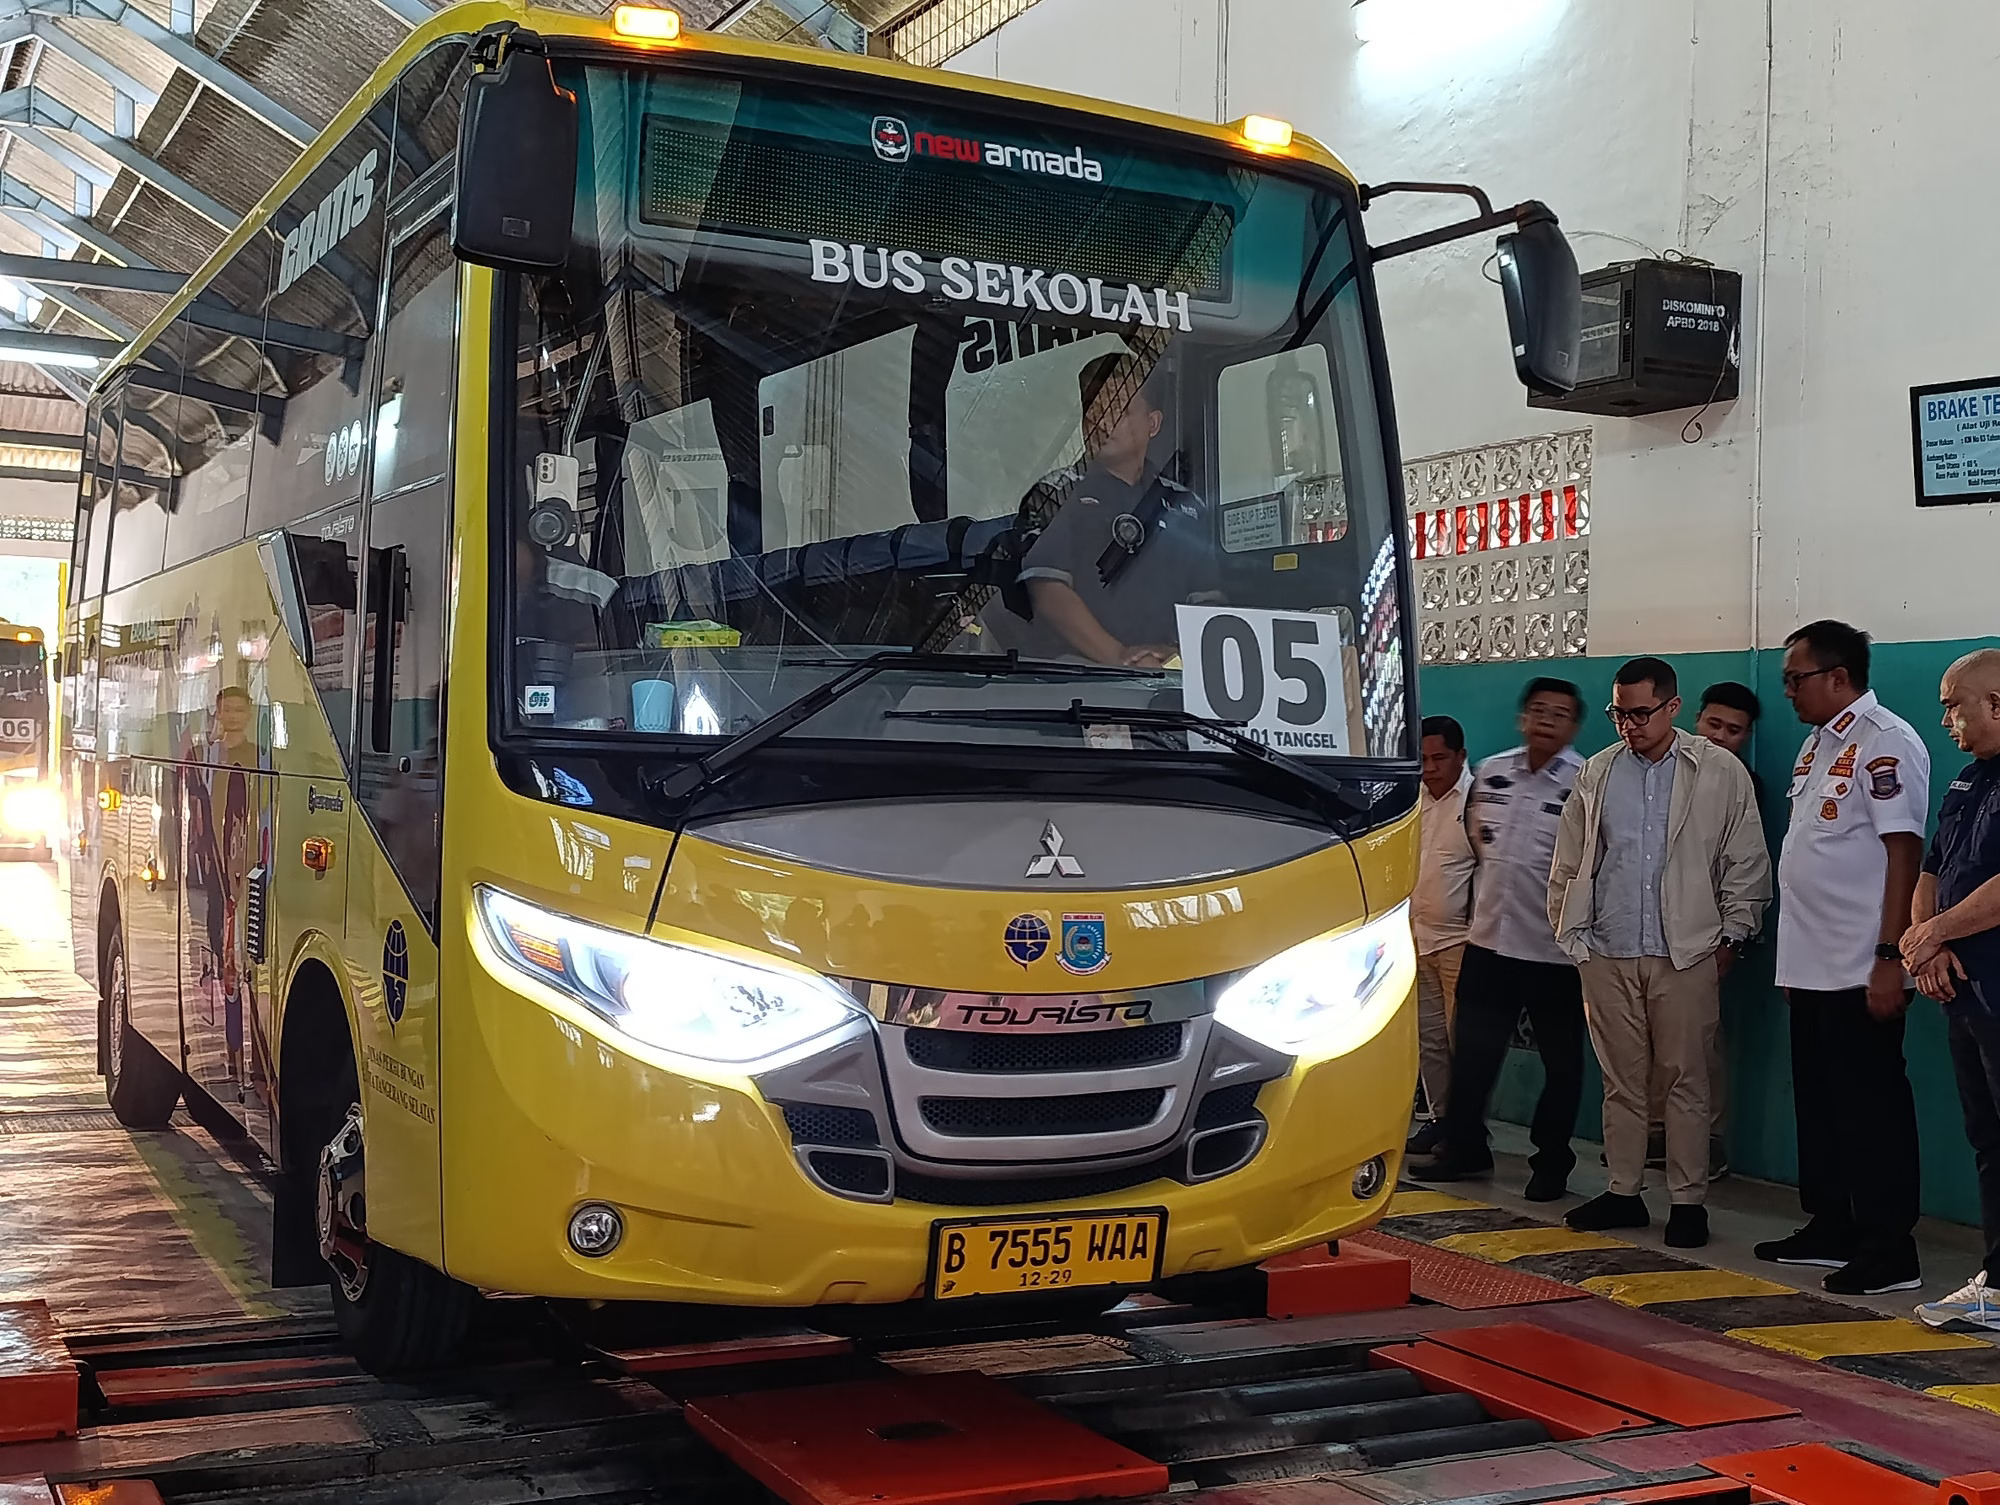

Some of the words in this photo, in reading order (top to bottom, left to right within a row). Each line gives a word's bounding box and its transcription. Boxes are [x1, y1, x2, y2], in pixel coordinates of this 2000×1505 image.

[914, 131, 980, 163] new
[983, 143, 1103, 182] armada
[278, 148, 378, 294] GRATIS
[808, 238, 926, 294] BUS
[941, 256, 1193, 332] SEKOLAH
[1667, 315, 1696, 329] APBD
[1697, 319, 1720, 332] 2018
[1927, 396, 1978, 421] BRAKE
[1201, 614, 1327, 726] 05
[2, 720, 30, 738] 06
[1250, 728, 1270, 746] 01
[1273, 731, 1337, 749] TANGSEL
[944, 1232, 967, 1274] B
[988, 1225, 1073, 1270] 7555
[1086, 1222, 1149, 1262] WAA
